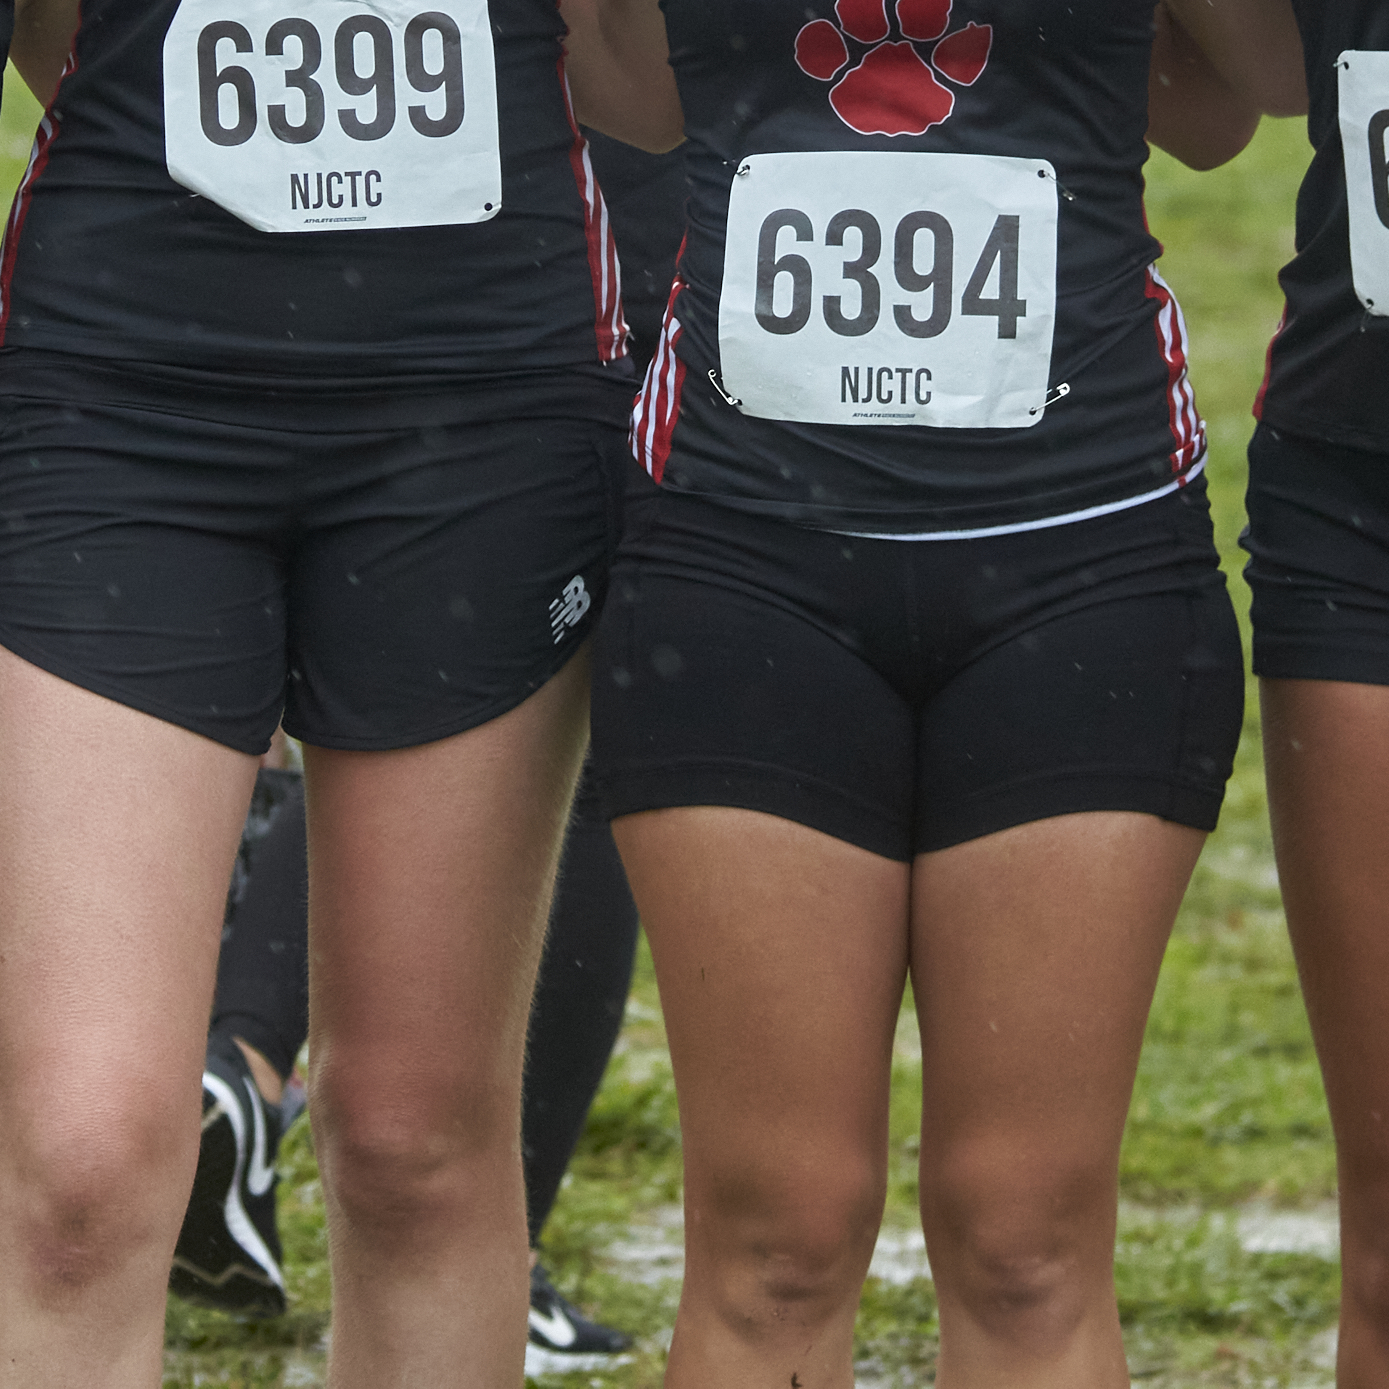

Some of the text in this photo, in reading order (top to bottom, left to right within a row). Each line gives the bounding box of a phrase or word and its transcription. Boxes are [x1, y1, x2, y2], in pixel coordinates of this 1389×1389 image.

[197, 11, 465, 147] 6399
[290, 170, 382, 210] NJCTC
[755, 208, 1027, 339] 6394
[840, 366, 932, 405] NJCTC
